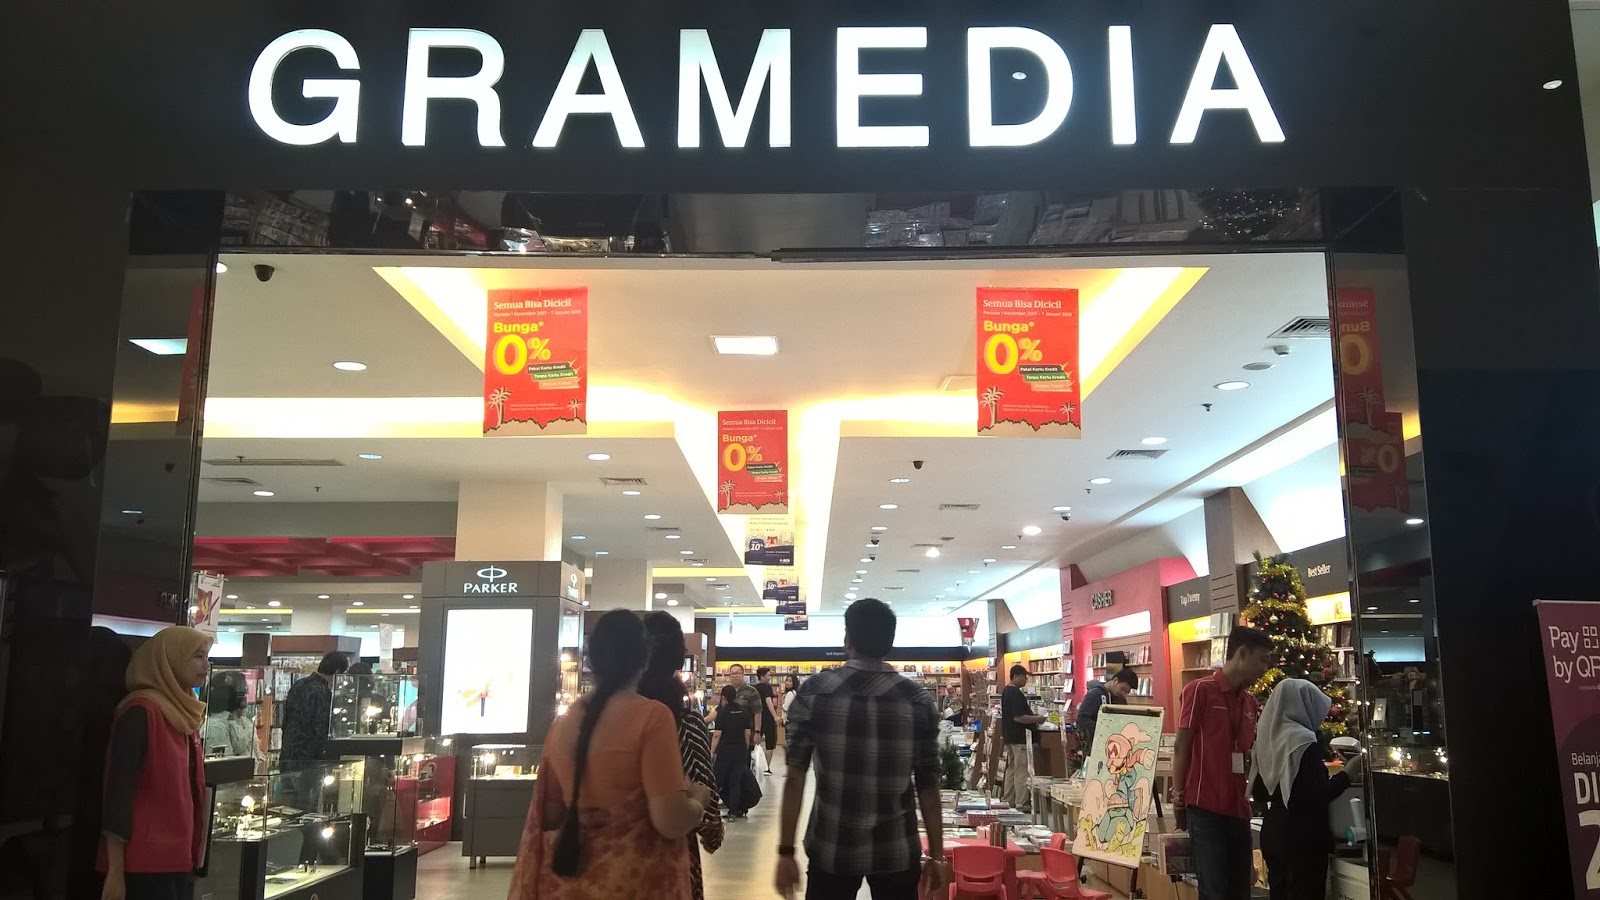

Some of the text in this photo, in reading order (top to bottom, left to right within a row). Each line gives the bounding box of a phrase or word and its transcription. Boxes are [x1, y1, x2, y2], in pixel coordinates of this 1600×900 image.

[248, 23, 1286, 149] GRAMEDIA
[493, 298, 572, 310] Semua Bisa Dicicil
[983, 300, 1062, 309] Semua Bisa Dicicil
[1307, 564, 1330, 577] Best Seller
[464, 582, 518, 593] PARKER
[1187, 593, 1200, 604] Twenty
[1548, 626, 1579, 654] Pay
[1552, 655, 1573, 684] by
[1574, 772, 1600, 805] DI
